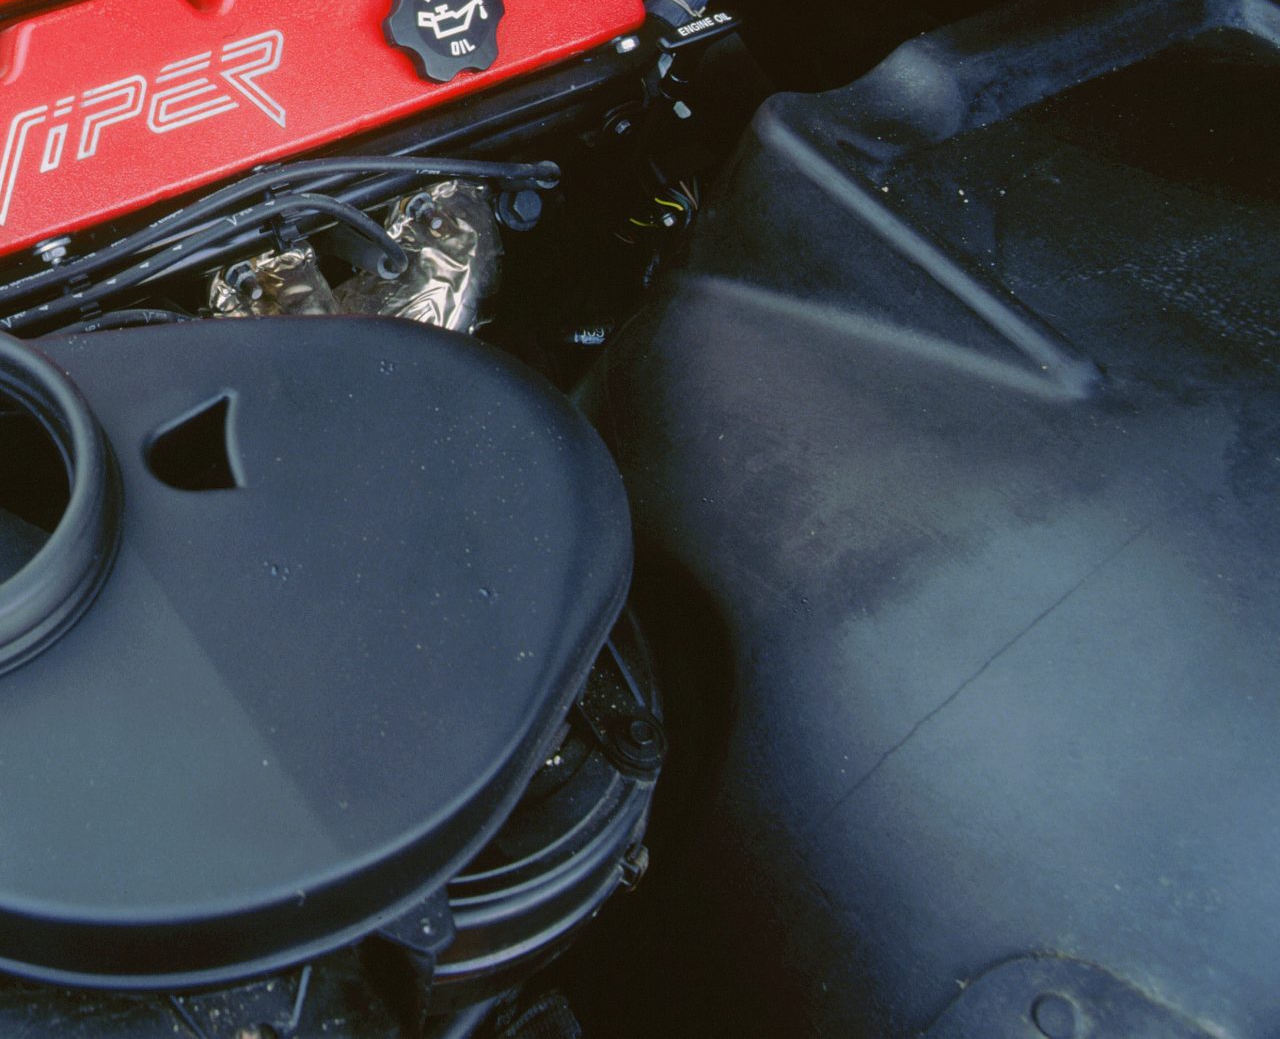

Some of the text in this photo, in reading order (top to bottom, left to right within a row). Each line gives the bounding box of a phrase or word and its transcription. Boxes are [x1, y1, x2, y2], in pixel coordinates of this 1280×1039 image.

[677, 12, 732, 37] ENGINE OIL
[450, 39, 476, 56] OIL
